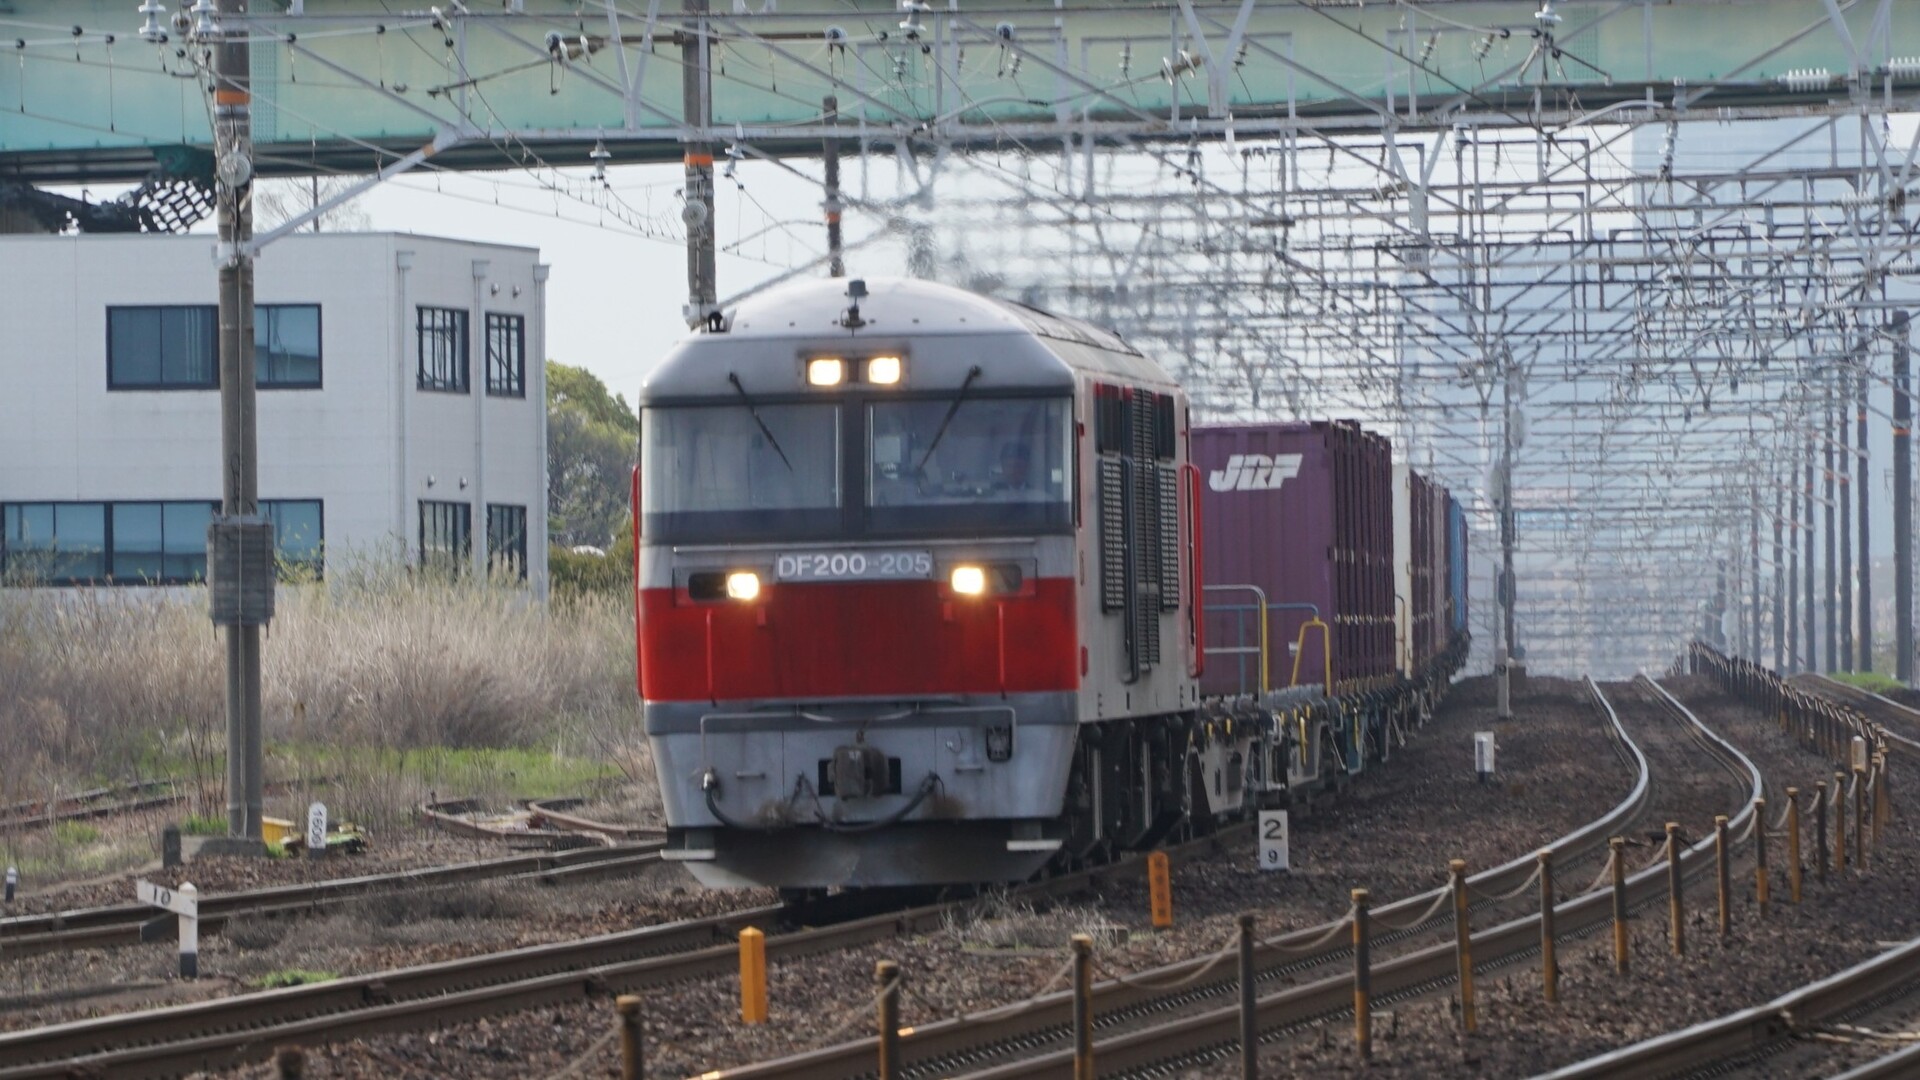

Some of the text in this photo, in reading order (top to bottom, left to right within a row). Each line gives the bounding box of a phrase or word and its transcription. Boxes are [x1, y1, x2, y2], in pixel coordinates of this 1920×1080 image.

[1209, 453, 1303, 492] JRF
[778, 552, 931, 577] DF200-205
[1264, 818, 1283, 840] 2
[1268, 849, 1278, 864] 9
[153, 885, 171, 906] 10
